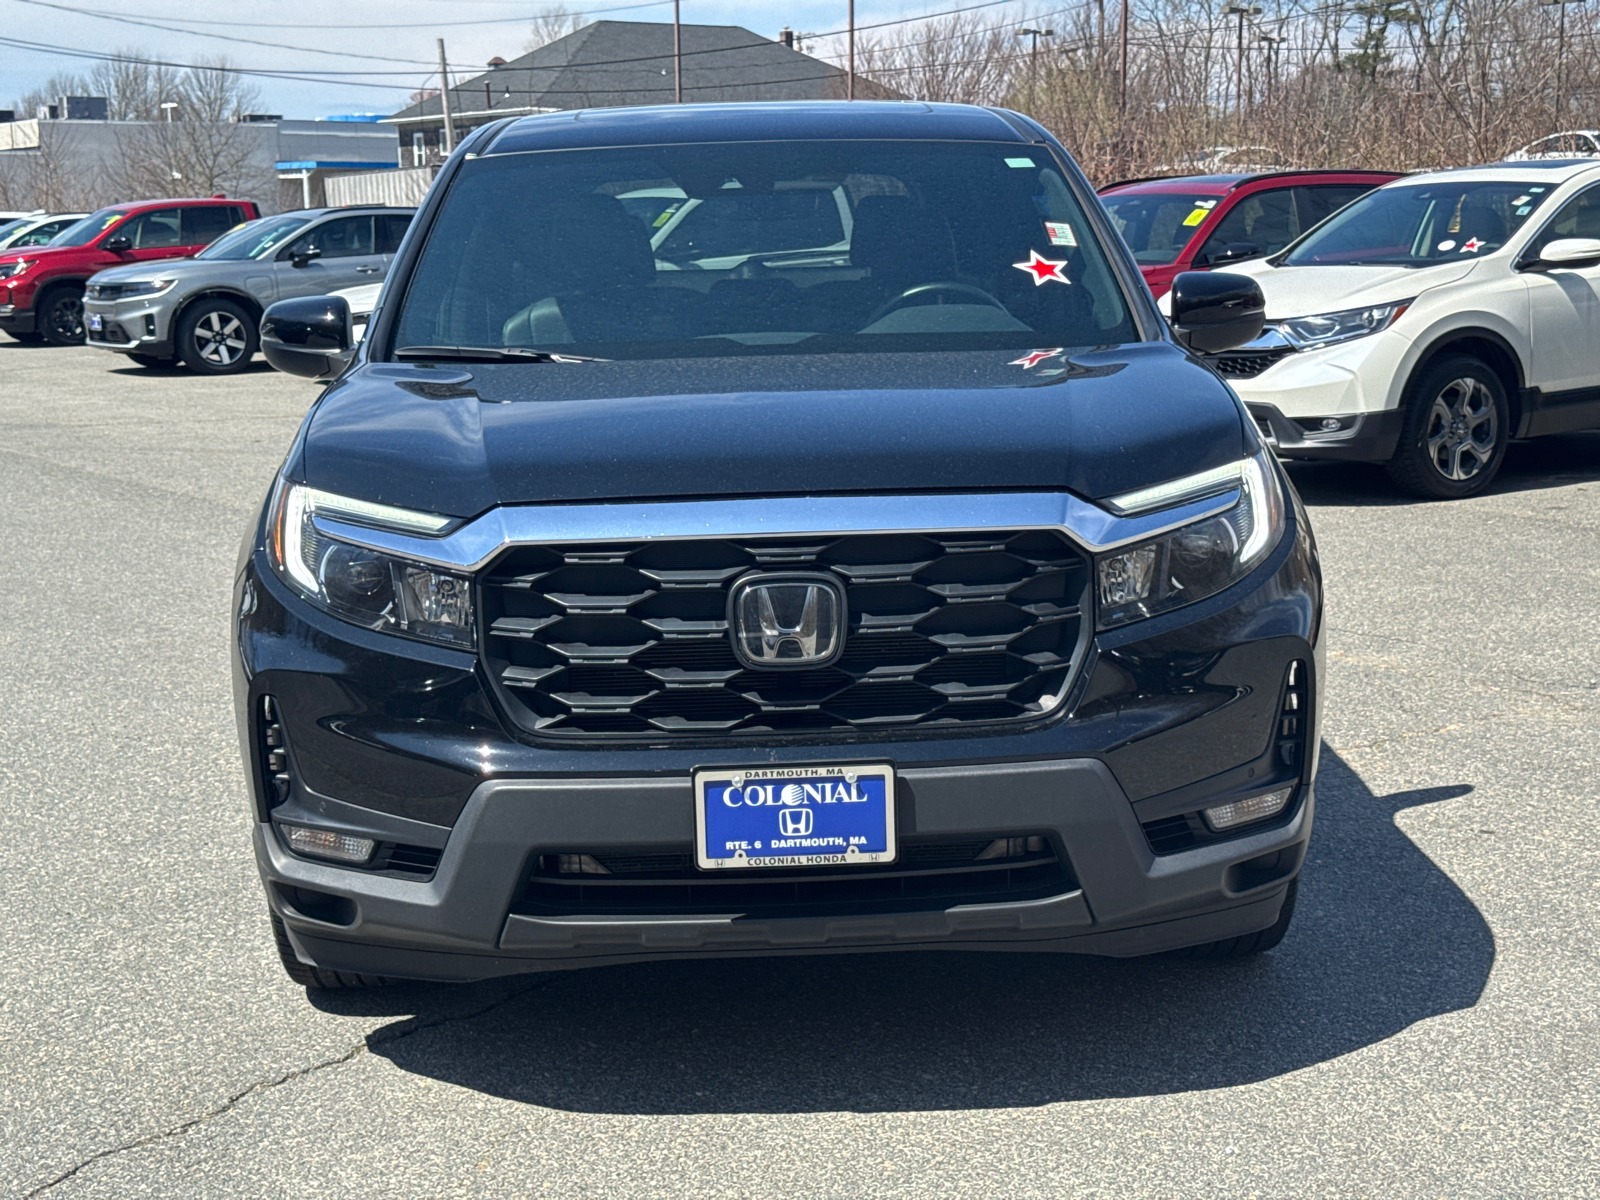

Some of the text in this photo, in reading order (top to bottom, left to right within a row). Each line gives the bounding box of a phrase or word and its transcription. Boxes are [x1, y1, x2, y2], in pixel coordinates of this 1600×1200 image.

[826, 768, 844, 776] MA
[722, 782, 868, 807] COLONIAL
[725, 836, 867, 850] RTE. 6 DARTMOUTH, MA
[747, 855, 847, 866] COLONIAL HONDA
